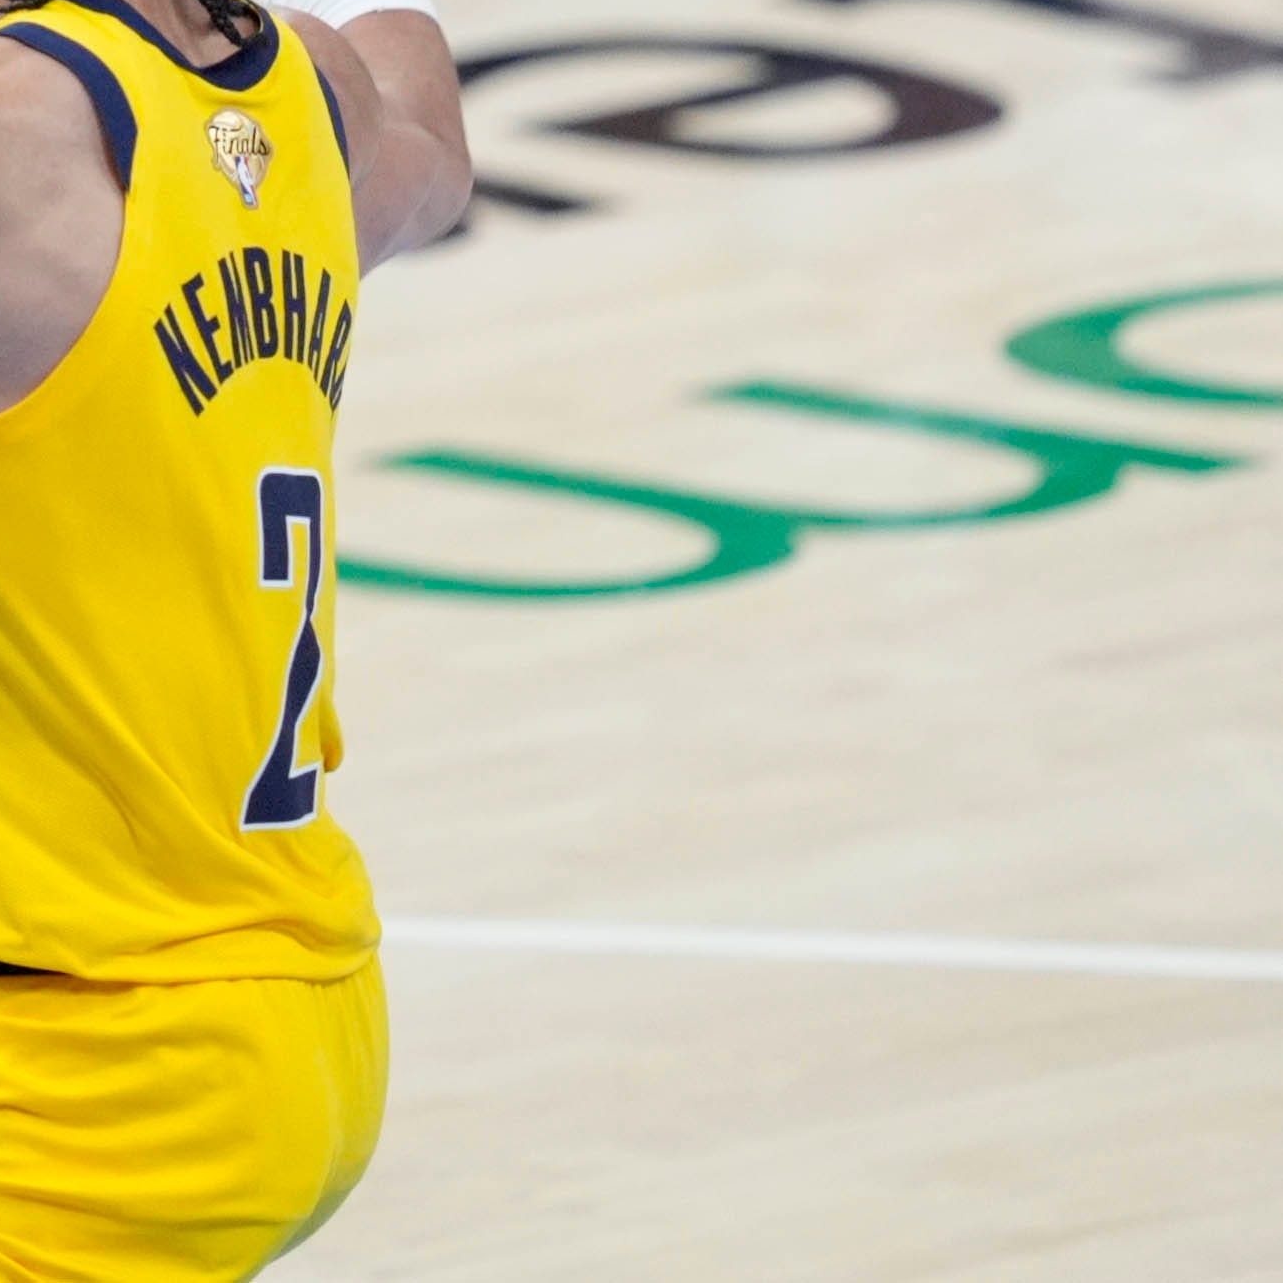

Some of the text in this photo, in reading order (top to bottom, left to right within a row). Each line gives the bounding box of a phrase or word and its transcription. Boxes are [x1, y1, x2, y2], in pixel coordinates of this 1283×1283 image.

[207, 123, 271, 165] Finals
[153, 246, 353, 417] NEMBHAR
[239, 466, 323, 831] 2
